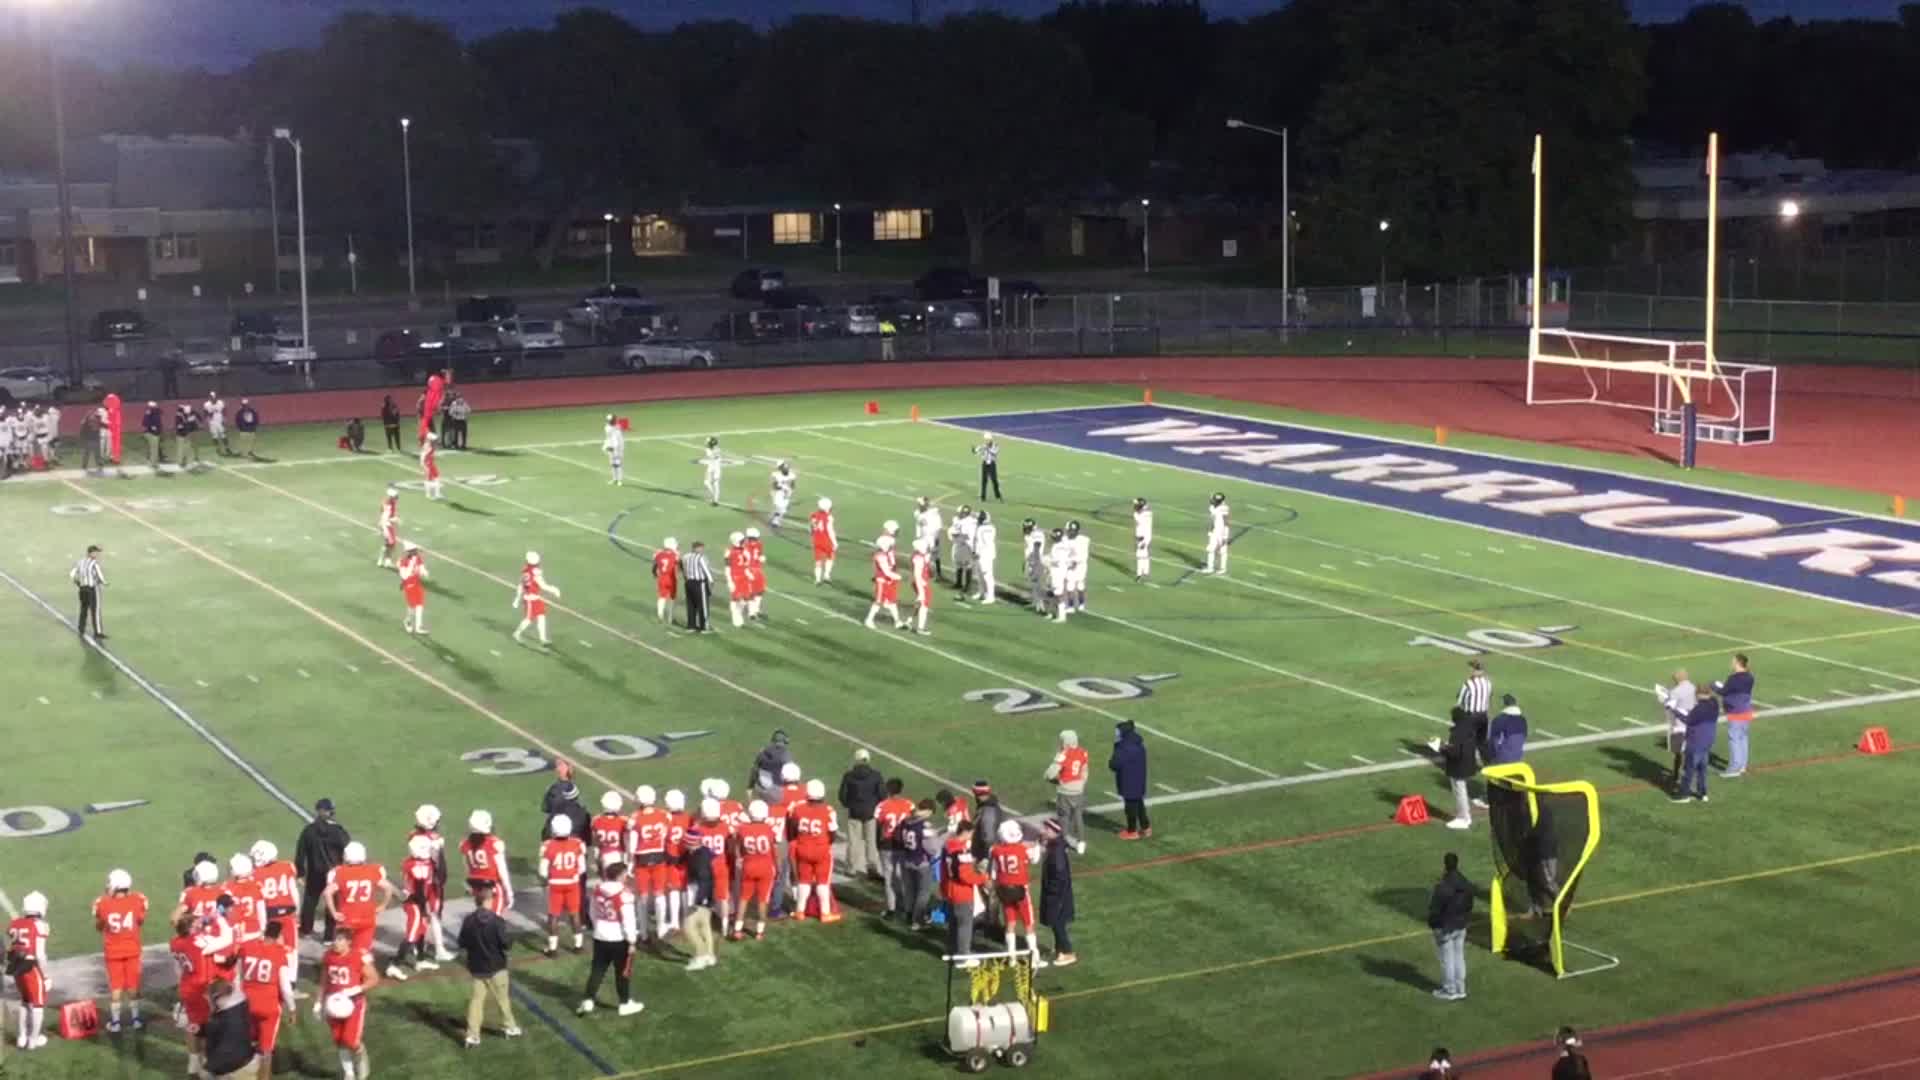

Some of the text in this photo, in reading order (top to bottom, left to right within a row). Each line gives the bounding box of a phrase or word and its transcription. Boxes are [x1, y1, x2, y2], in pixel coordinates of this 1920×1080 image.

[961, 677, 1154, 714] 20
[459, 733, 667, 776] 30
[1406, 800, 1425, 820] 20
[467, 848, 488, 869] 19
[551, 850, 577, 871] 40
[999, 855, 1020, 875] 12
[263, 873, 289, 899] 84
[346, 880, 372, 902] 73
[107, 911, 133, 933] 54
[244, 956, 272, 983] 78
